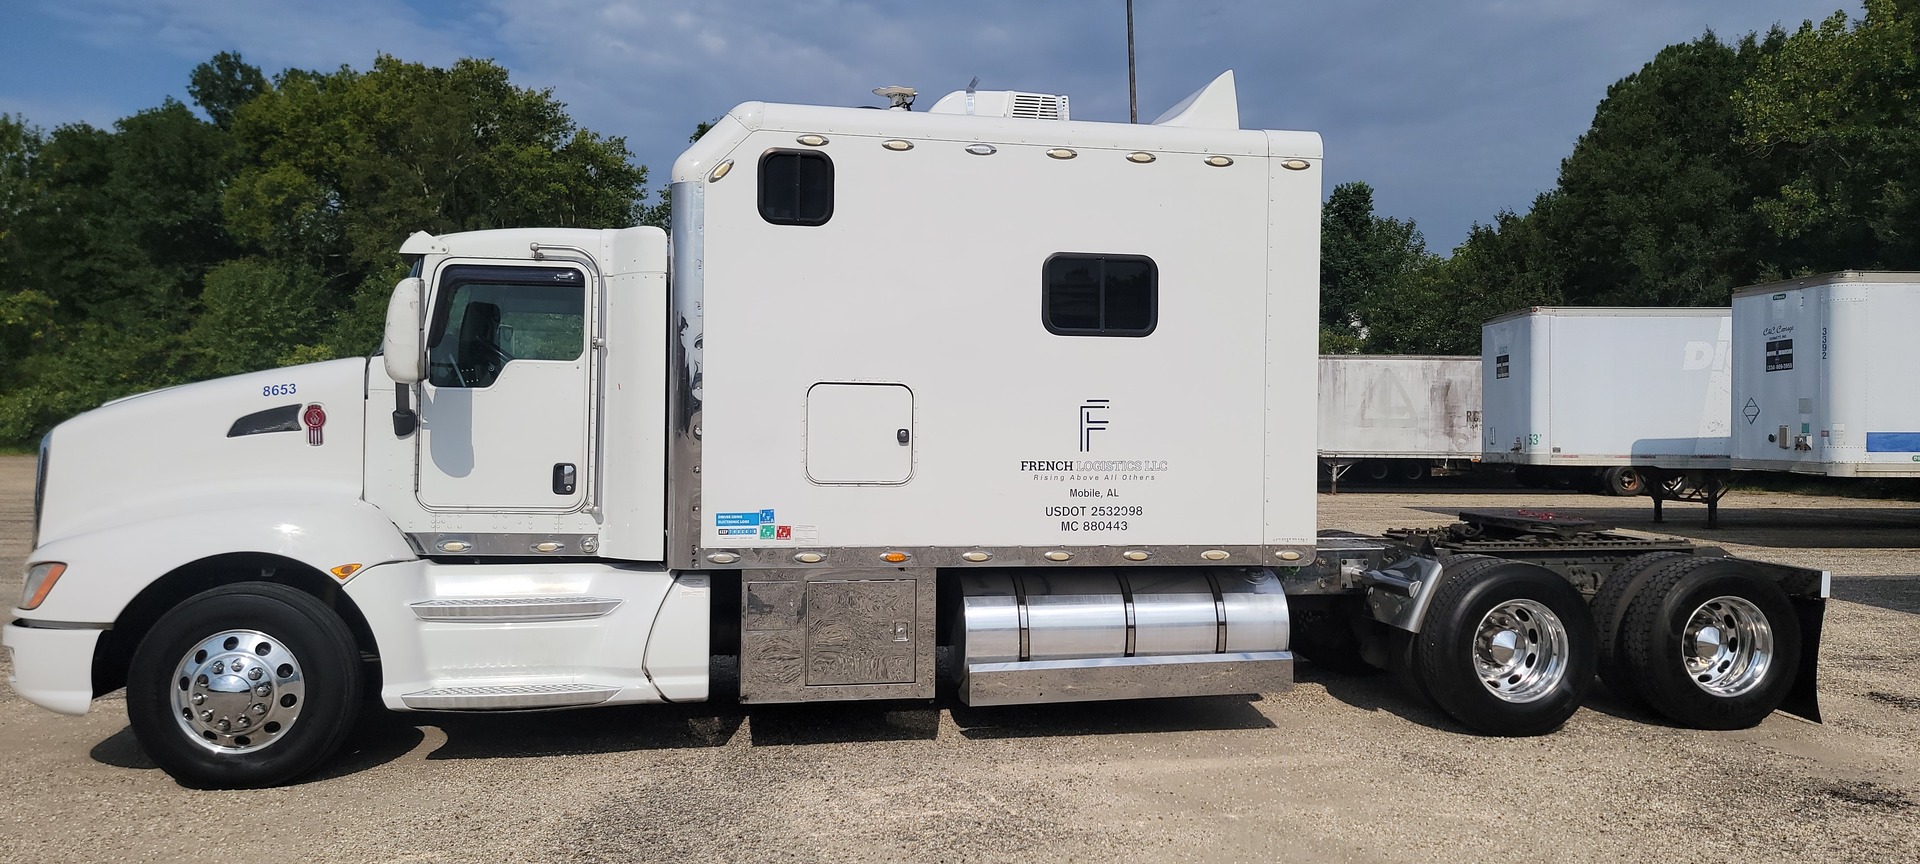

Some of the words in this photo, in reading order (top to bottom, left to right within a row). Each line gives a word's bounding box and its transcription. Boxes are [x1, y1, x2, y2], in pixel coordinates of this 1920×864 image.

[262, 383, 297, 397] 8653
[1020, 460, 1074, 472] FRENCH
[1076, 460, 1143, 472] LOGISTICS
[1144, 460, 1168, 472] LLC
[1033, 474, 1065, 482] Rising
[1069, 488, 1103, 499] Mobile,
[1106, 488, 1120, 498] AL
[1045, 506, 1087, 517] USDOT
[1061, 521, 1079, 532] MC
[1082, 520, 1128, 532] 880443
